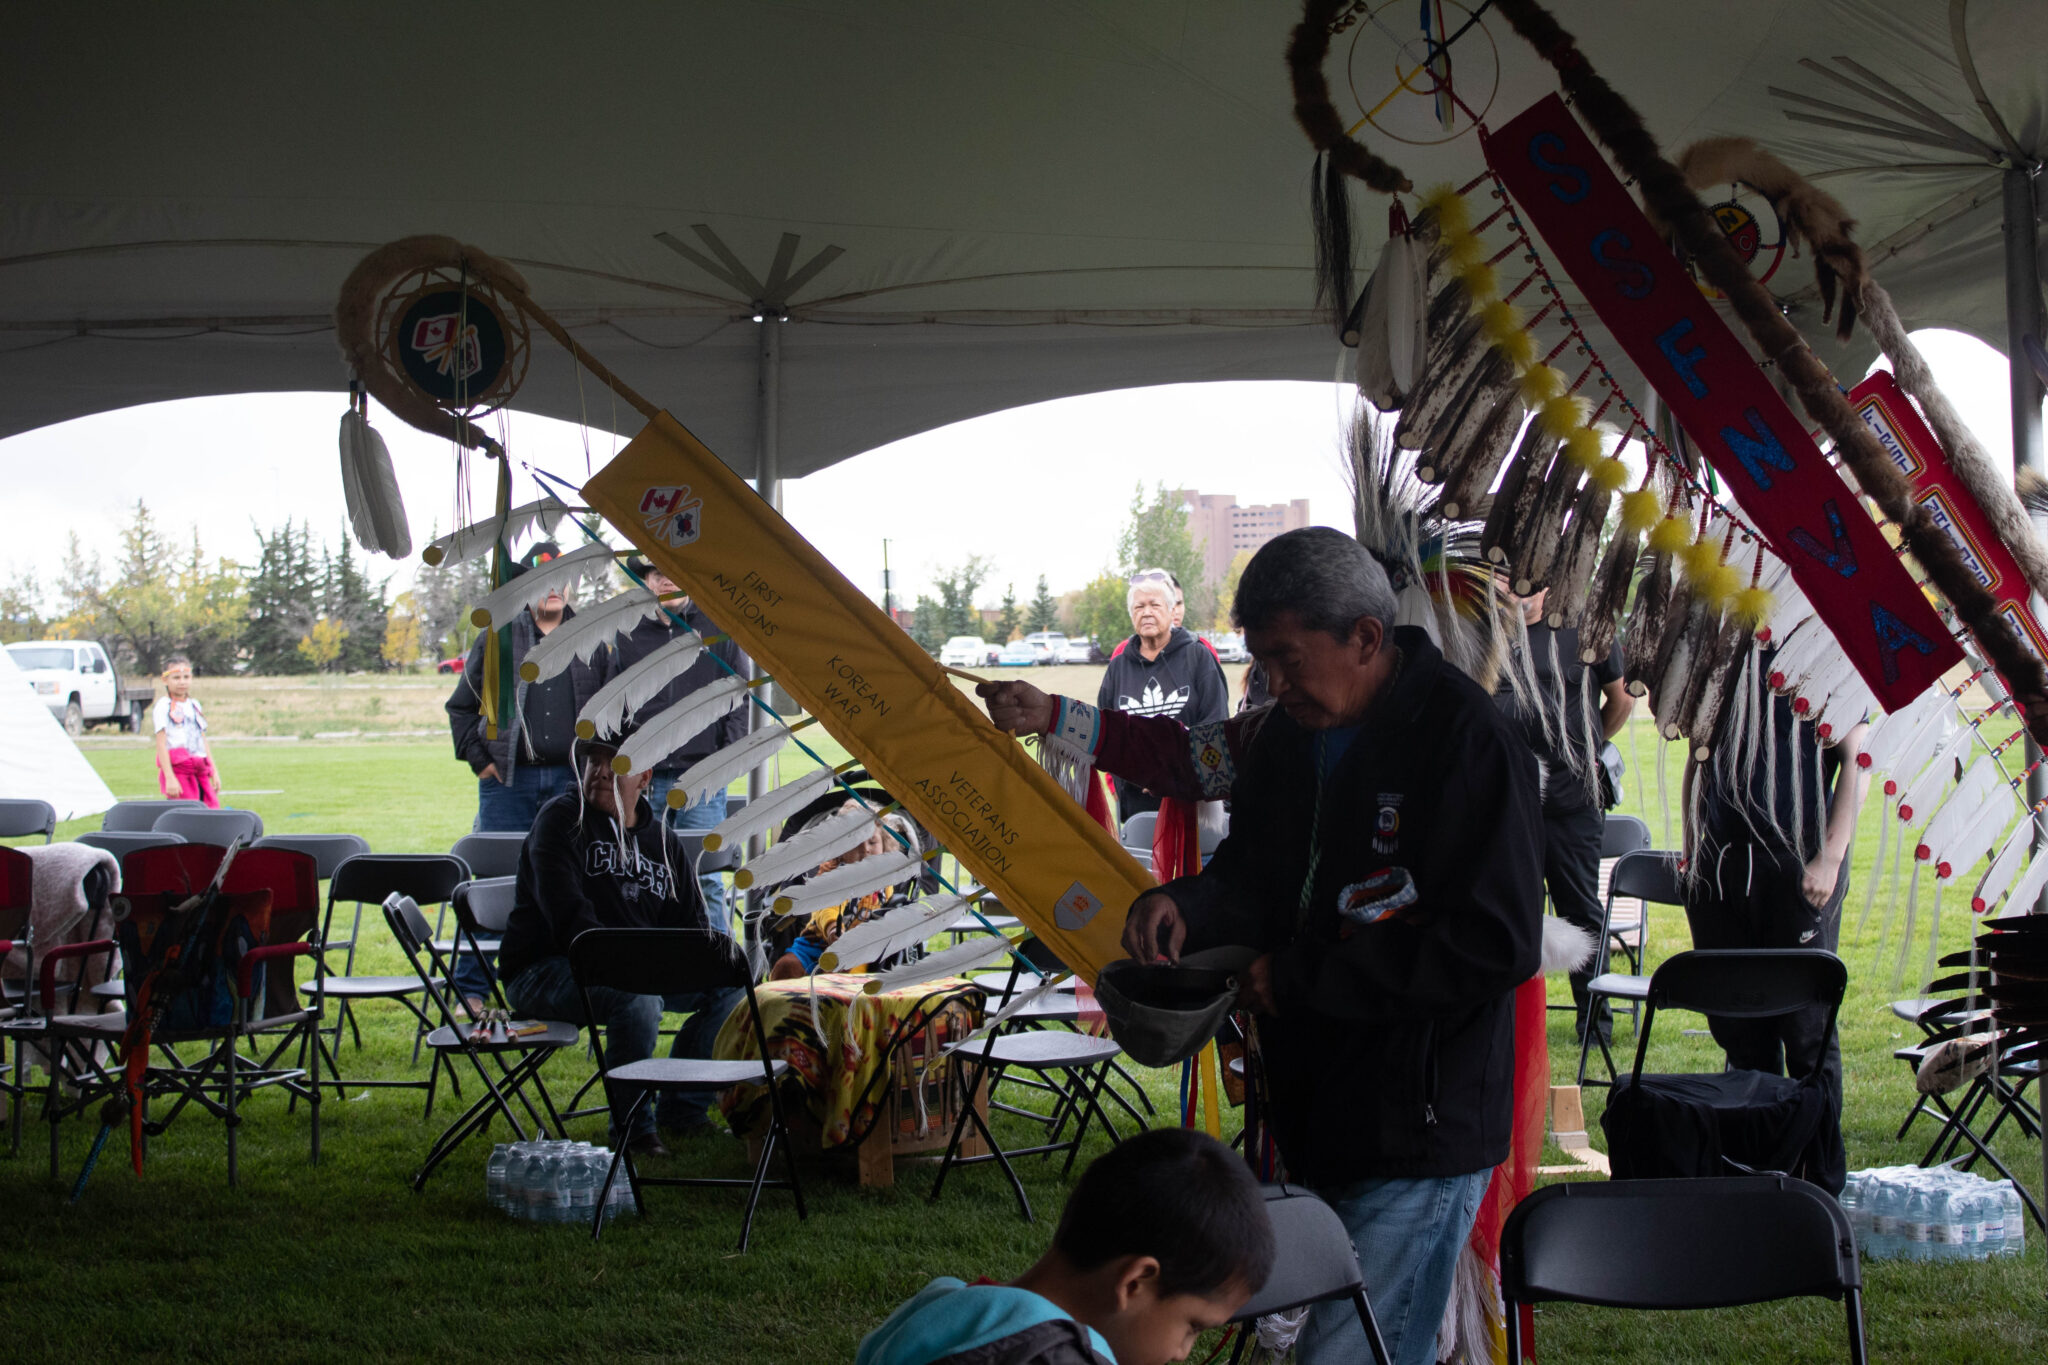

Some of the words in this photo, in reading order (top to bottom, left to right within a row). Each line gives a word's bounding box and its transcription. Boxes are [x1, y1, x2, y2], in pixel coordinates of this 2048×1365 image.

[1861, 407, 1910, 473] FIRST
[712, 572, 779, 637] NATIONS
[743, 570, 784, 607] FIRST
[824, 682, 862, 721] WAR
[826, 653, 892, 717] KOREAN
[915, 778, 1013, 873] ASSOCIATION
[949, 770, 1020, 846] VETERANS
